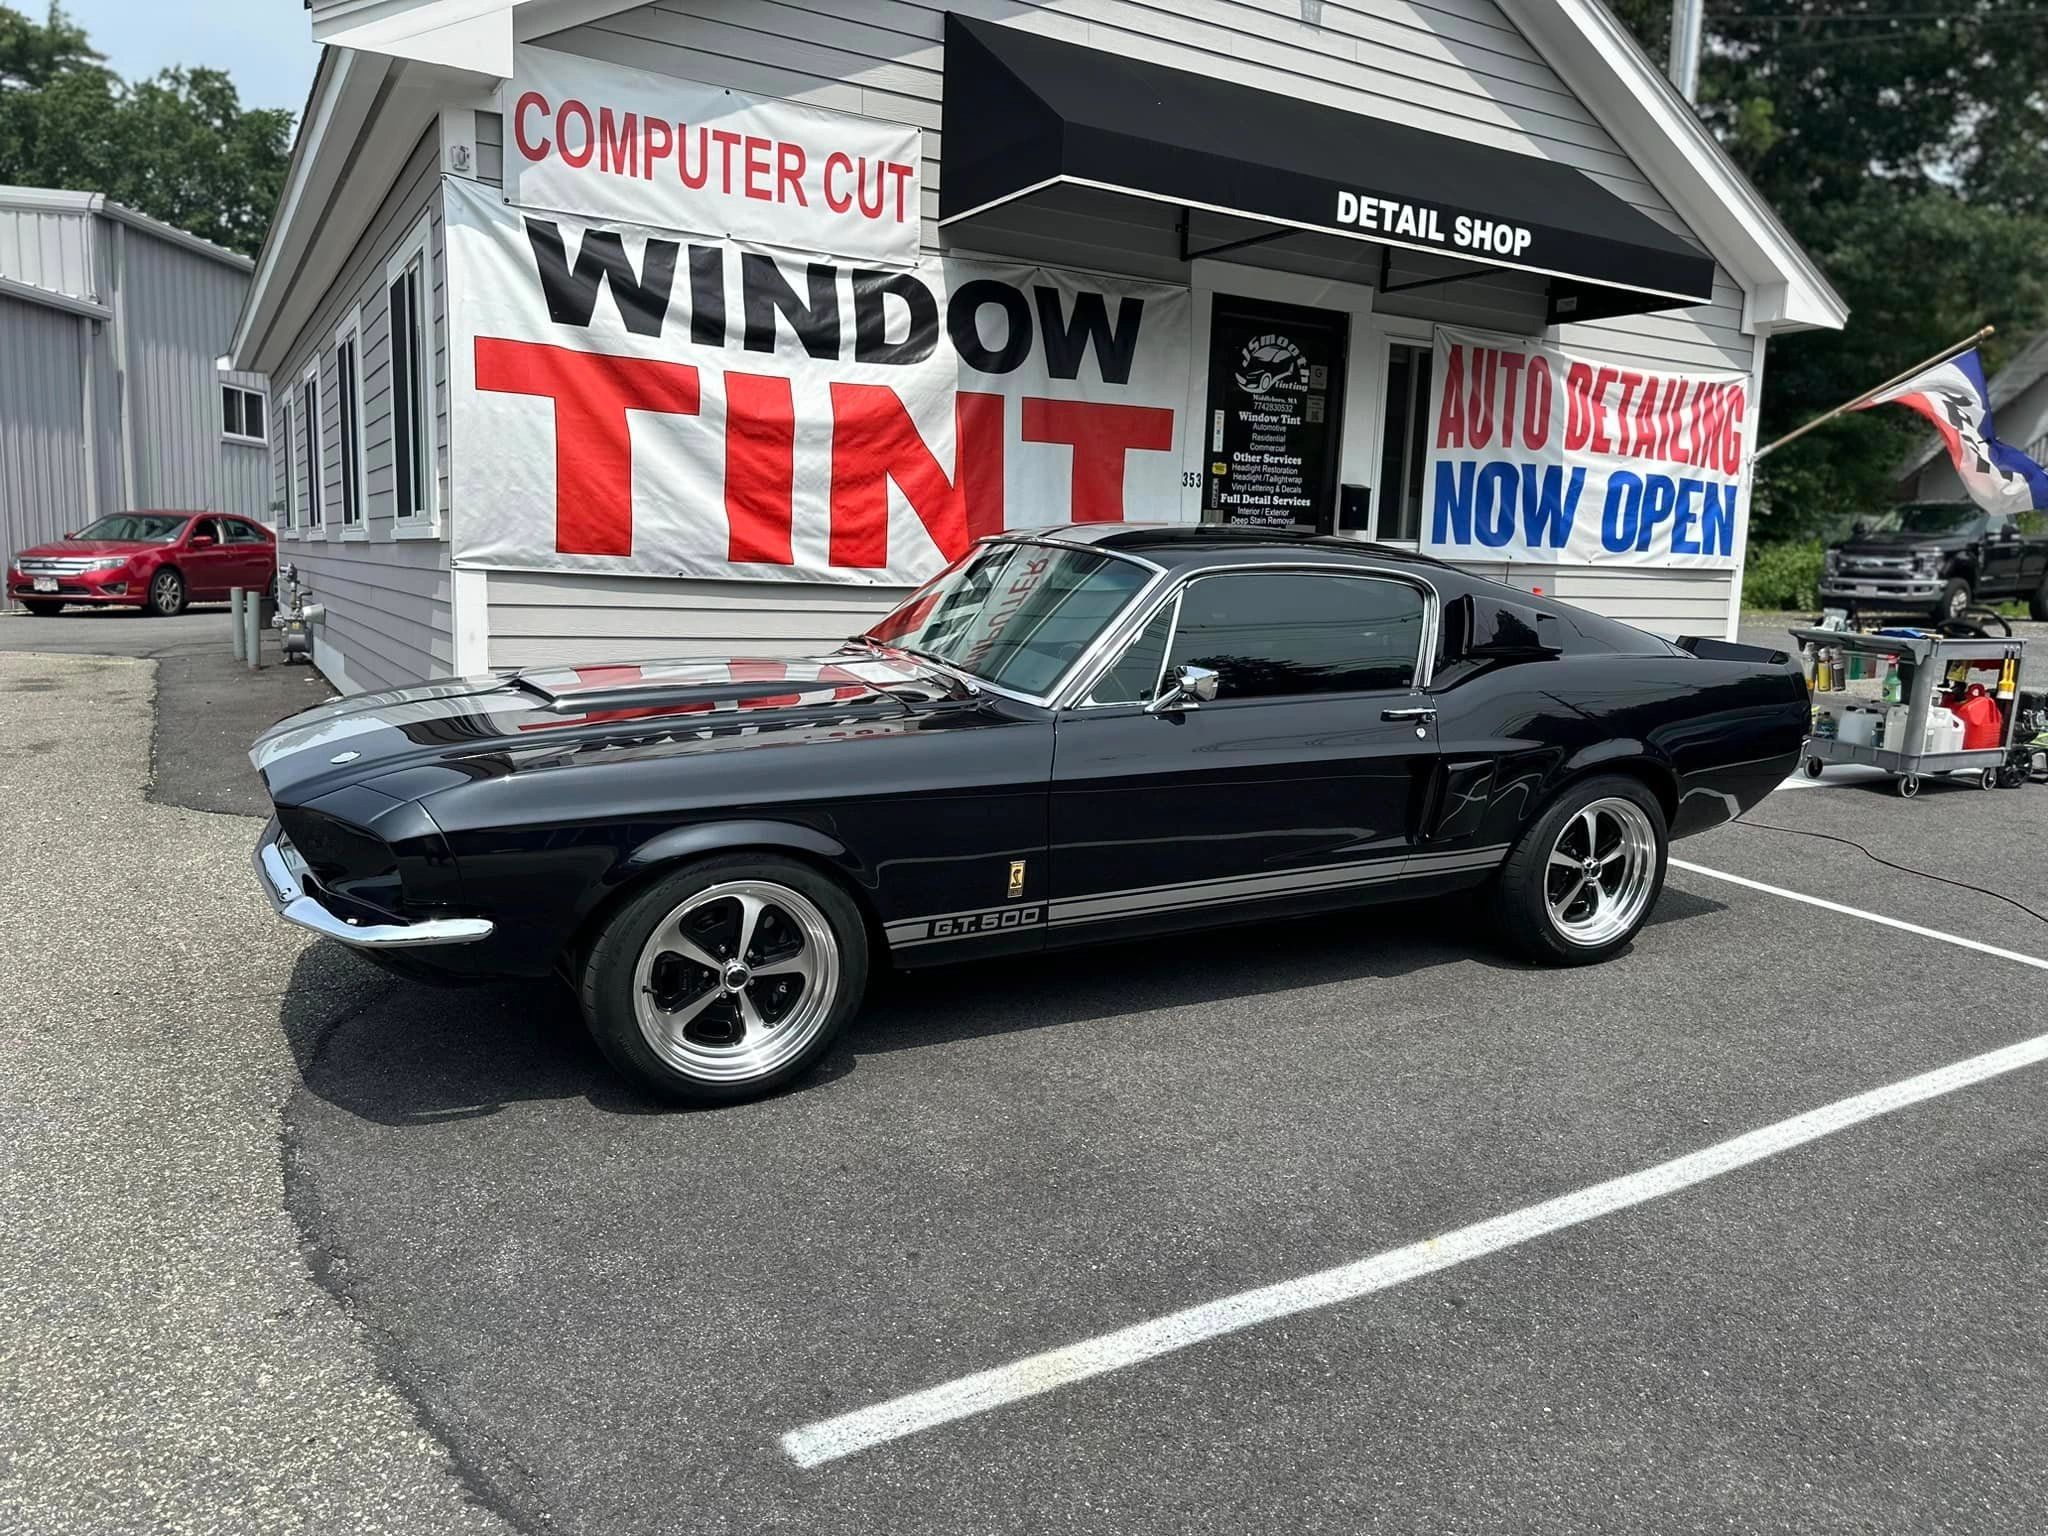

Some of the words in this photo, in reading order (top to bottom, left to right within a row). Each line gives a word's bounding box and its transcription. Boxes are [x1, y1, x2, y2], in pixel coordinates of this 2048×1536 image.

[514, 91, 808, 208] COMPUTER
[824, 151, 914, 223] CUT
[1337, 191, 1444, 242] DETAIL
[1454, 215, 1532, 256] SHOP
[524, 218, 1145, 384] WINDOW
[1436, 344, 1553, 451] AUTO
[1564, 362, 1745, 476] DETAILING
[1238, 411, 1279, 423] Window
[1281, 414, 1301, 425] Tint
[1252, 422, 1287, 432] Automotive
[1252, 432, 1286, 443] Residential
[475, 336, 1174, 568] TINT
[1250, 442, 1286, 452] Commercial
[1233, 451, 1262, 463] Other
[1263, 453, 1302, 465] Services
[1231, 463, 1261, 473] Headlight
[1262, 464, 1298, 475] Restoration
[1182, 471, 1201, 488] 353
[1231, 482, 1247, 493] Vinyl
[1248, 483, 1274, 494] Lettering
[1281, 484, 1302, 493] Decals
[1220, 493, 1240, 503] Full
[1242, 494, 1271, 505] Detail
[1272, 495, 1311, 506] Services
[1237, 506, 1260, 516] Interior
[1265, 507, 1289, 516] Exterior
[1431, 461, 1586, 548] NOW
[1601, 470, 1737, 556] OPEN
[1231, 515, 1249, 526] Deep
[1249, 516, 1266, 525] Stain
[1267, 516, 1295, 526] Removal
